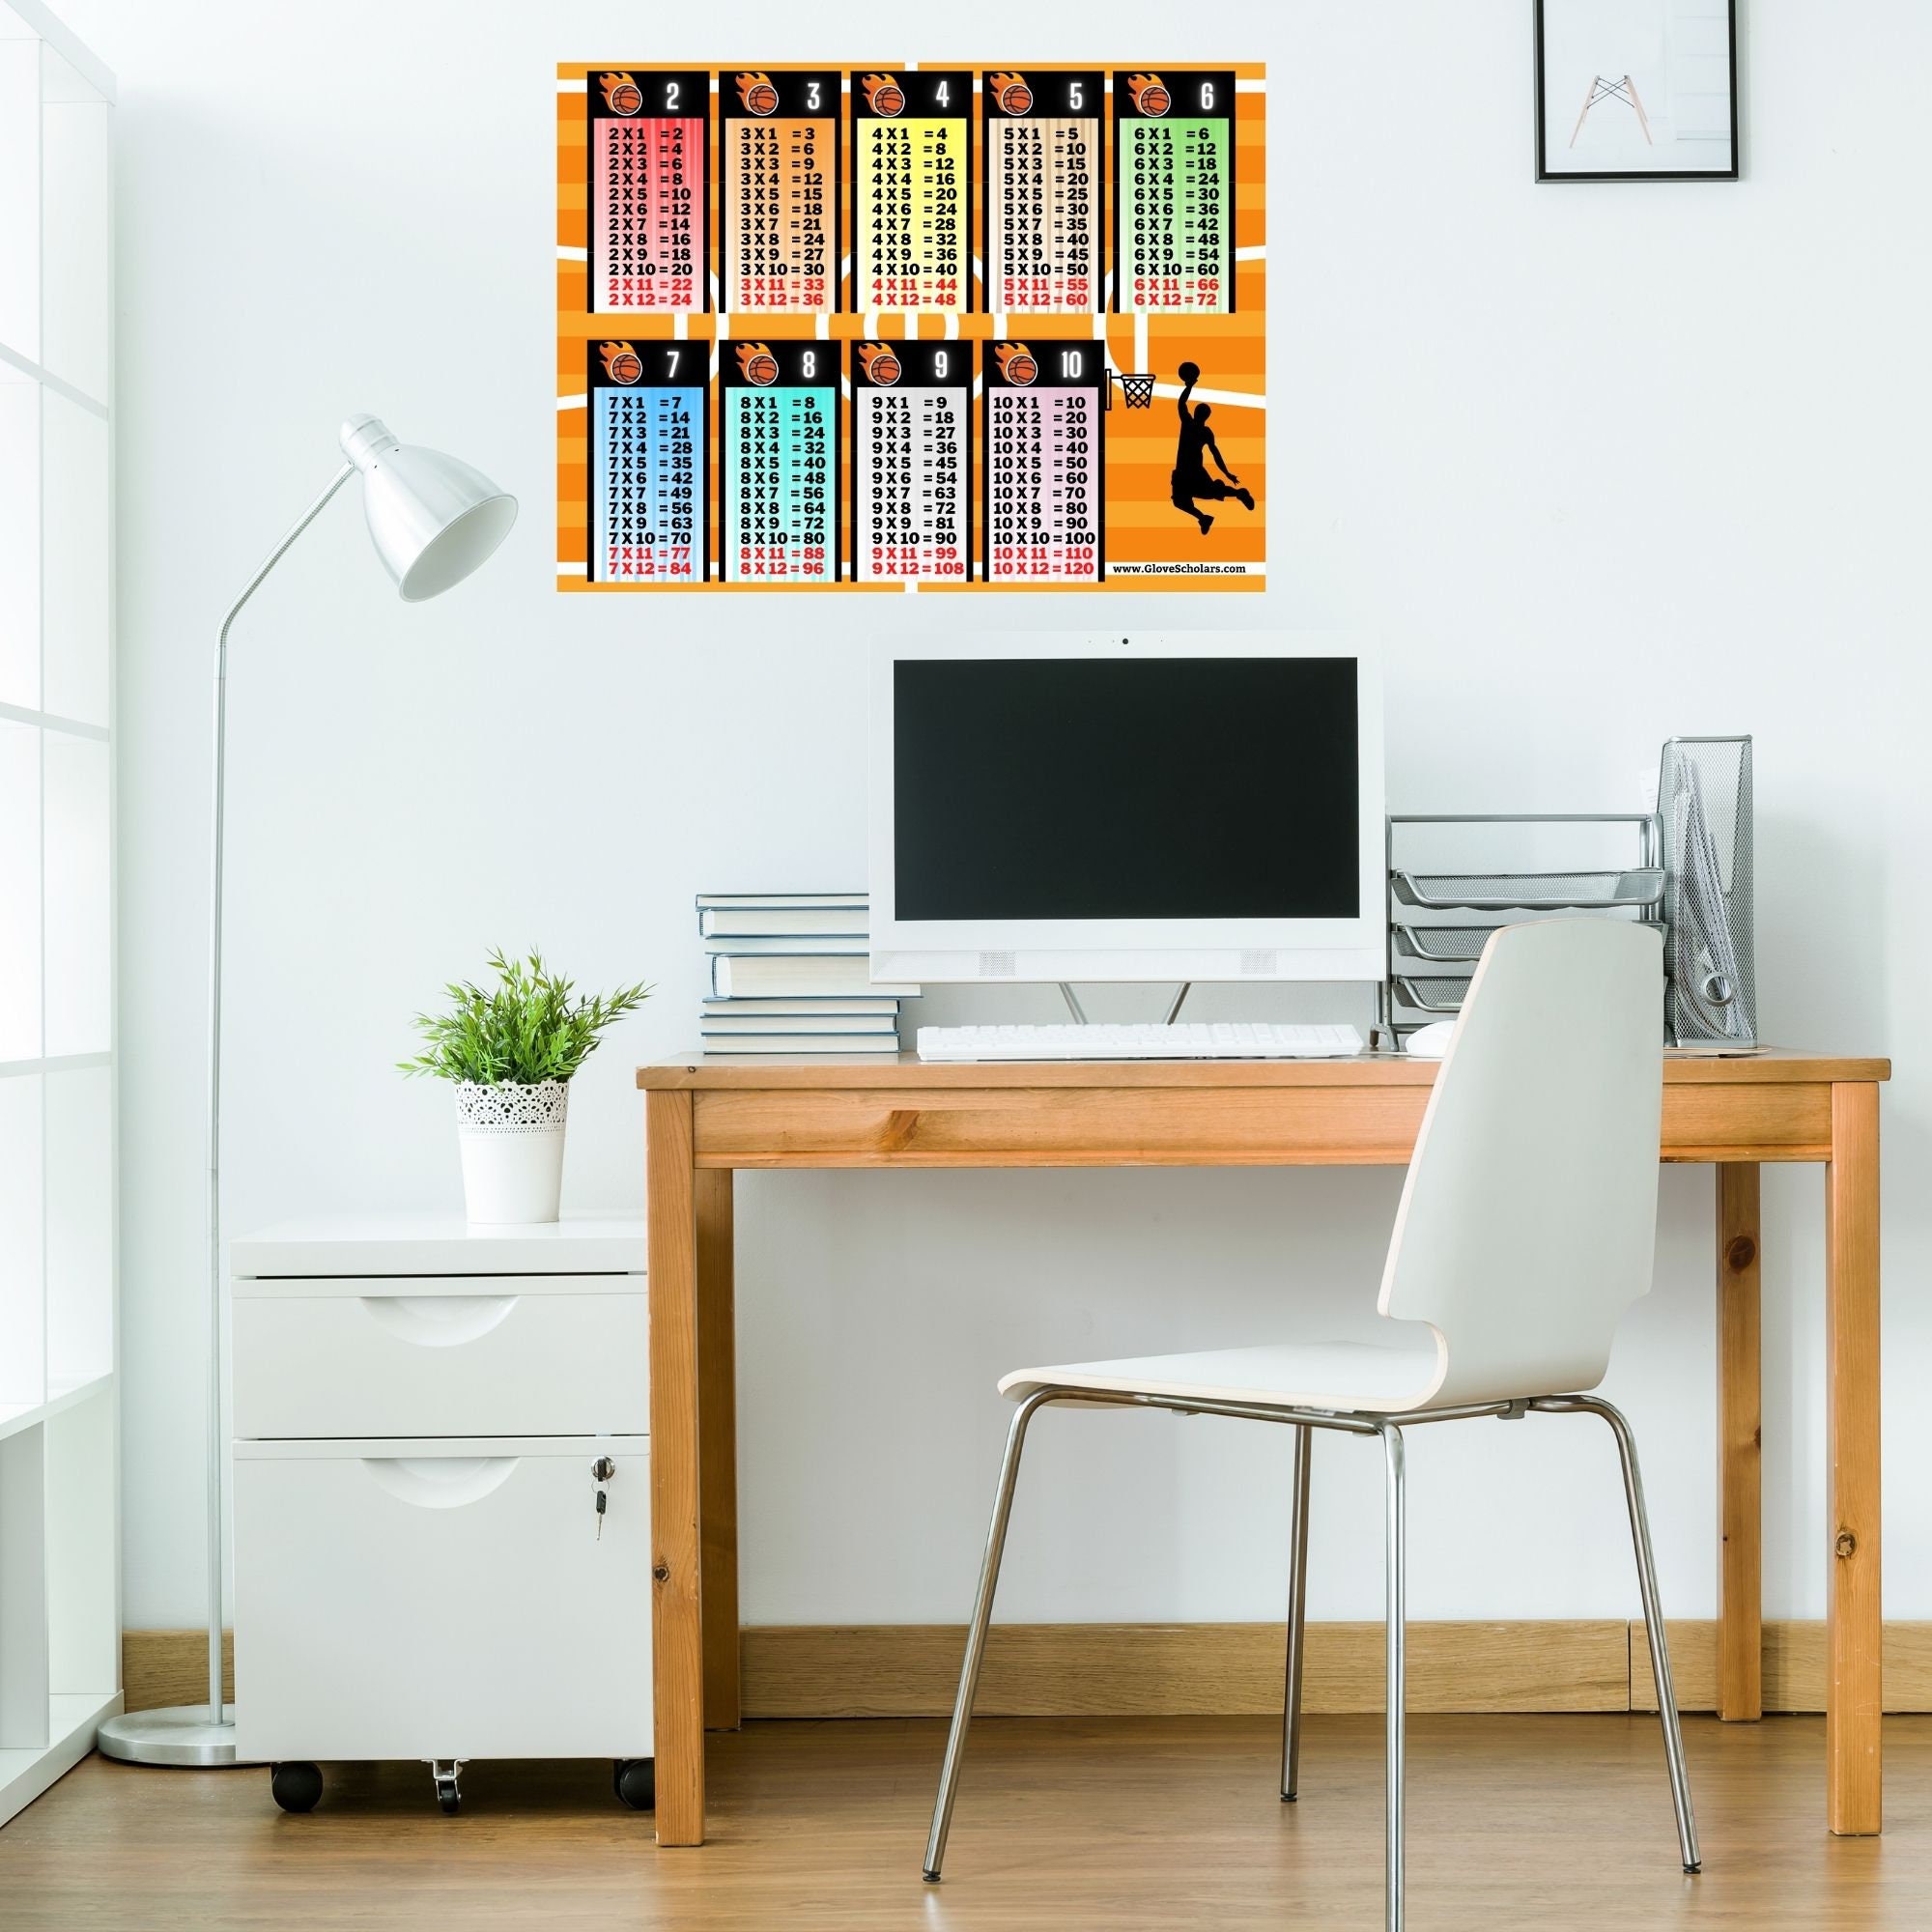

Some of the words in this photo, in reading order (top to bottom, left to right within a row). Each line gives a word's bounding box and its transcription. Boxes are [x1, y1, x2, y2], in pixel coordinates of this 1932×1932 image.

[667, 82, 679, 110] 2
[807, 82, 820, 110] 3
[935, 80, 950, 108] 4
[1069, 82, 1083, 110] 5
[1201, 82, 1214, 110] 6
[609, 127, 619, 140] 2
[637, 128, 645, 140] 1
[672, 127, 683, 140] 2
[740, 142, 752, 156] 3
[768, 142, 780, 156] 2
[803, 142, 814, 156] 6
[871, 157, 884, 171] 4
[900, 157, 912, 171] 3
[935, 156, 954, 171] 12
[1004, 172, 1015, 185] 5
[1032, 172, 1043, 185] 4
[1066, 172, 1090, 185] 20
[1134, 187, 1146, 201] 6
[1162, 187, 1174, 201] 5
[1197, 187, 1220, 201] 30
[609, 202, 619, 215] 2
[637, 202, 648, 215] 6
[671, 202, 691, 215] 12
[740, 217, 752, 231] 3
[768, 217, 779, 231] 7
[802, 217, 822, 231] 21
[871, 233, 884, 246] 4
[900, 233, 912, 246] 8
[935, 233, 957, 246] 32
[1004, 247, 1015, 261] 5
[1032, 247, 1043, 261] 9
[1066, 247, 1090, 261] 45
[609, 263, 619, 276] 2
[637, 263, 657, 276] 10
[670, 263, 694, 276] 20
[871, 263, 884, 276] 4
[900, 263, 921, 276] 10
[935, 263, 958, 276] 40
[1134, 263, 1146, 276] 6
[1162, 263, 1182, 276] 10
[1197, 263, 1220, 276] 60
[1134, 278, 1146, 291] 6
[1162, 278, 1179, 291] 11
[1197, 278, 1219, 291] 66
[741, 293, 752, 306] 3
[768, 293, 787, 306] 12
[803, 293, 824, 306] 36
[1004, 293, 1015, 306] 5
[1032, 293, 1051, 306] 12
[1065, 293, 1088, 306] 60
[667, 351, 680, 379] 7
[802, 351, 815, 379] 8
[934, 351, 948, 379] 9
[1061, 351, 1082, 379] 10
[993, 396, 1013, 410] 10
[1031, 396, 1039, 410] 1
[1065, 396, 1087, 410] 10
[740, 411, 752, 424] 8
[768, 411, 780, 424] 2
[803, 411, 823, 424] 16
[609, 426, 619, 440] 7
[636, 426, 647, 440] 3
[670, 426, 691, 440] 21
[871, 440, 883, 455] 9
[900, 440, 912, 455] 4
[935, 440, 958, 455] 36
[993, 456, 1013, 469] 10
[1031, 456, 1042, 469] 5
[1065, 456, 1088, 469] 50
[609, 471, 619, 485] 7
[636, 471, 647, 485] 6
[670, 471, 693, 485] 42
[740, 486, 752, 499] 8
[768, 486, 779, 499] 7
[803, 486, 825, 499] 56
[871, 501, 883, 515] 9
[900, 501, 912, 515] 8
[935, 501, 956, 515] 72
[993, 516, 1013, 529] 10
[1031, 516, 1042, 529] 9
[1065, 516, 1089, 529] 90
[740, 531, 752, 545] 8
[768, 531, 788, 545] 10
[803, 531, 826, 545] 80
[993, 531, 1013, 545] 10
[1031, 531, 1051, 545] 10
[1065, 531, 1096, 545] 100
[609, 562, 619, 575] 7
[636, 562, 655, 575] 12
[669, 562, 692, 575] 84
[872, 562, 883, 575] 9
[900, 562, 920, 575] 12
[934, 562, 965, 575] 108
[1112, 563, 1246, 574] www.GloveScholars.com
